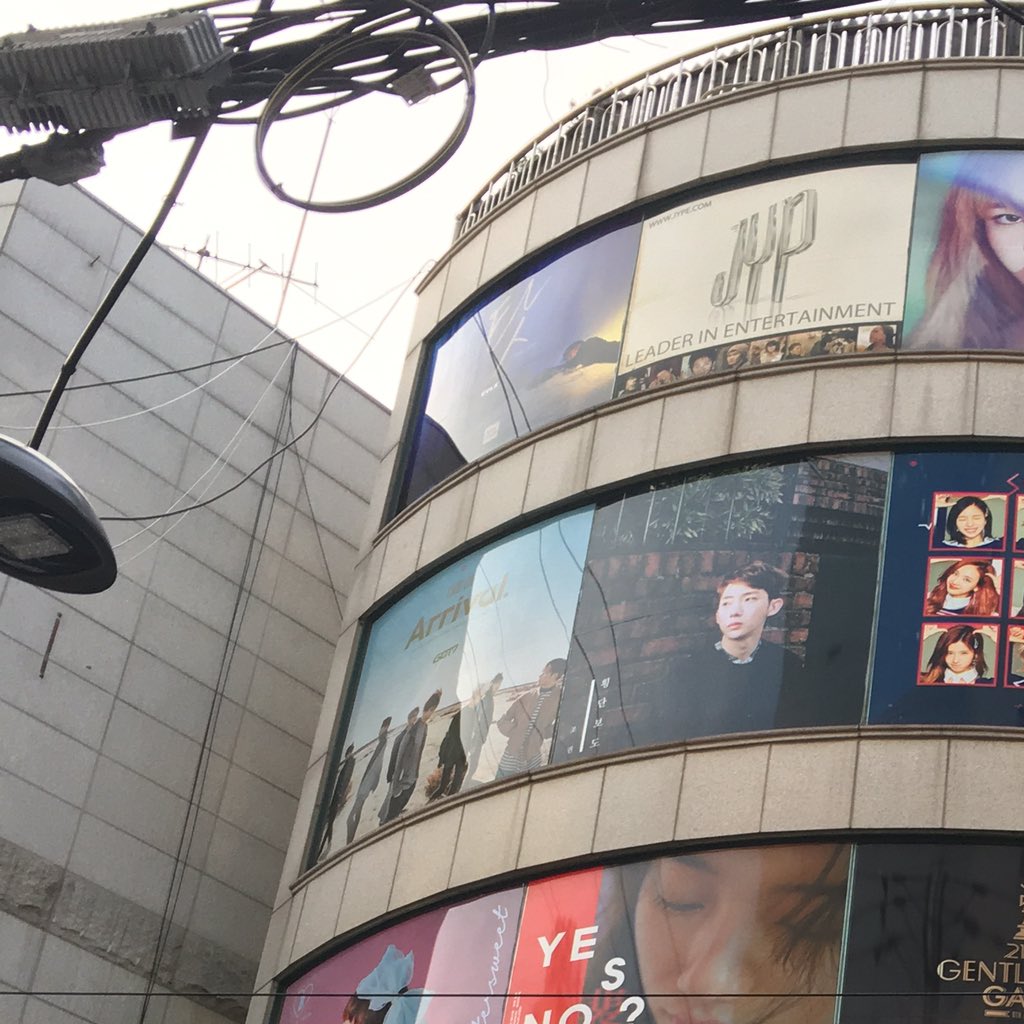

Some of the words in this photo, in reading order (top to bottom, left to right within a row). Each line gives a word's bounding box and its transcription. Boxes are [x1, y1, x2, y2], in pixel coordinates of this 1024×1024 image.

[710, 189, 818, 307] JYP
[625, 333, 694, 368] LEADER
[698, 327, 718, 344] IN
[723, 302, 896, 338] ENTERTAINMENT
